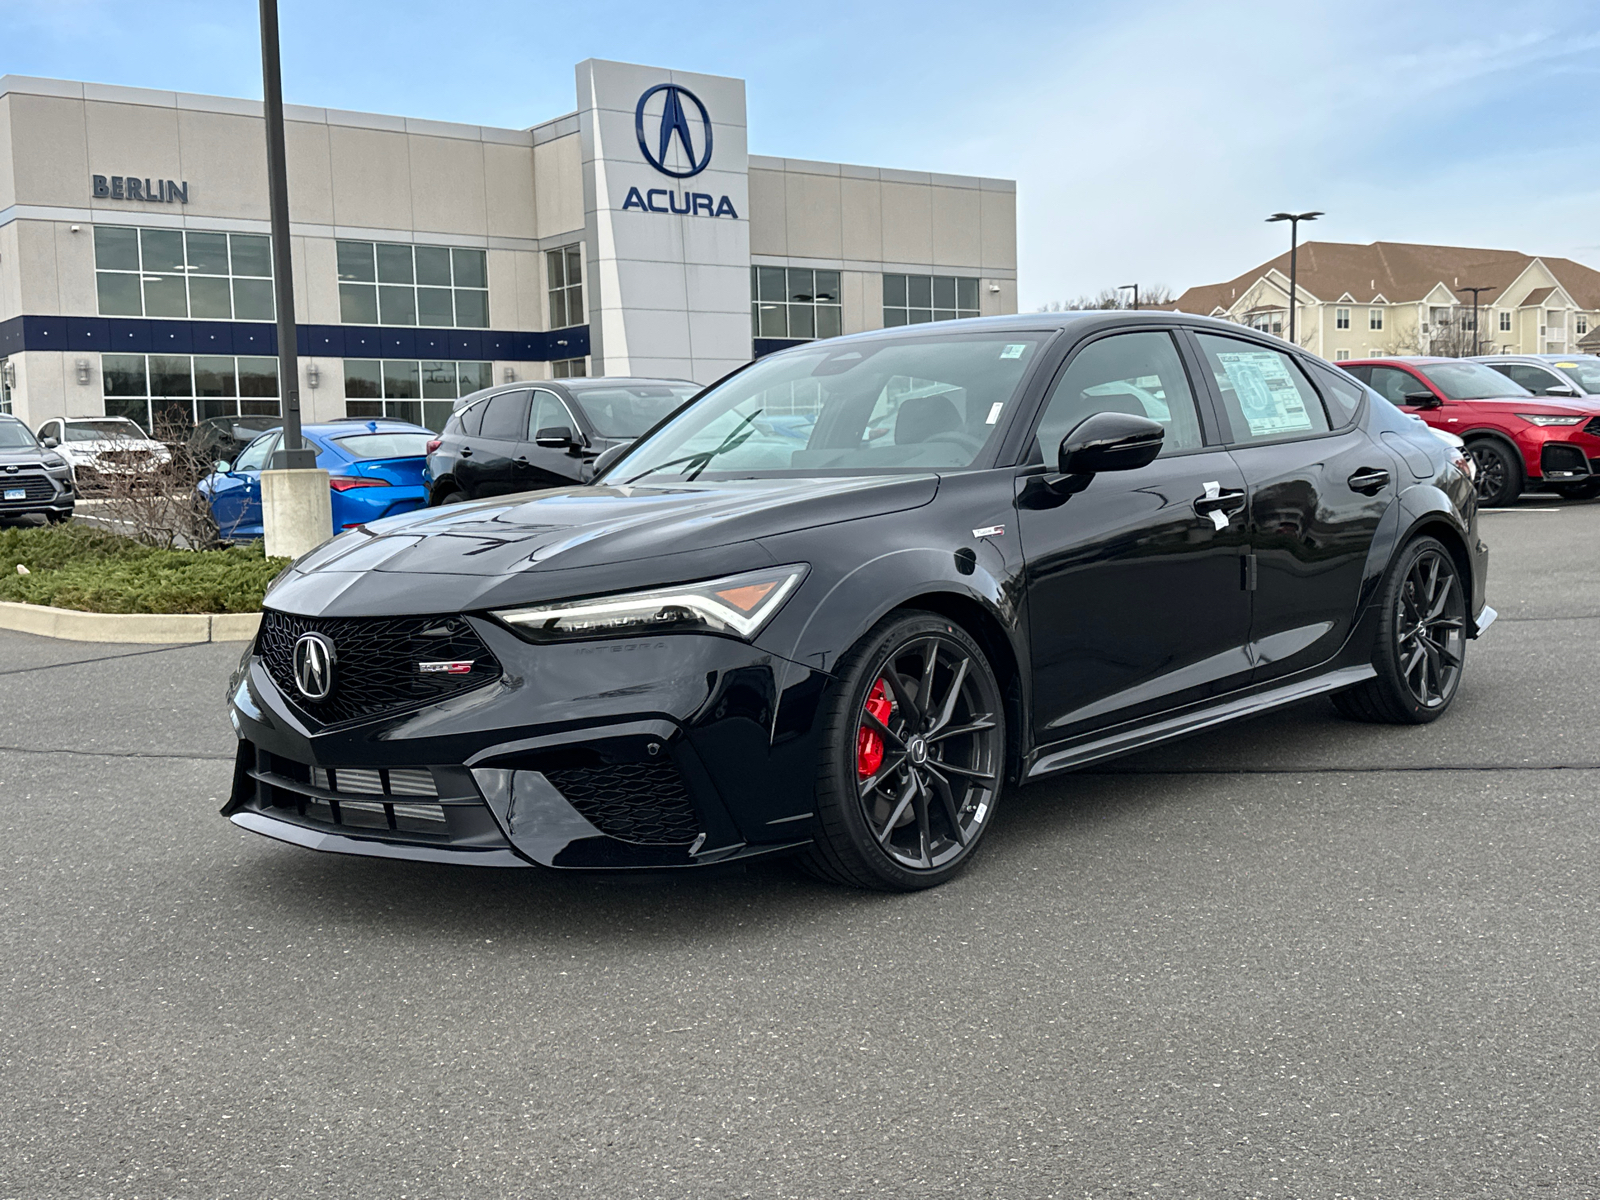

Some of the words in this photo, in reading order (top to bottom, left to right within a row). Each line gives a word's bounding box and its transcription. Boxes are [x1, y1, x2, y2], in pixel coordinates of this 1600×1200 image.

[92, 174, 188, 204] BERLIN
[622, 186, 738, 219] ACURA
[574, 642, 668, 655] INTEGRA
